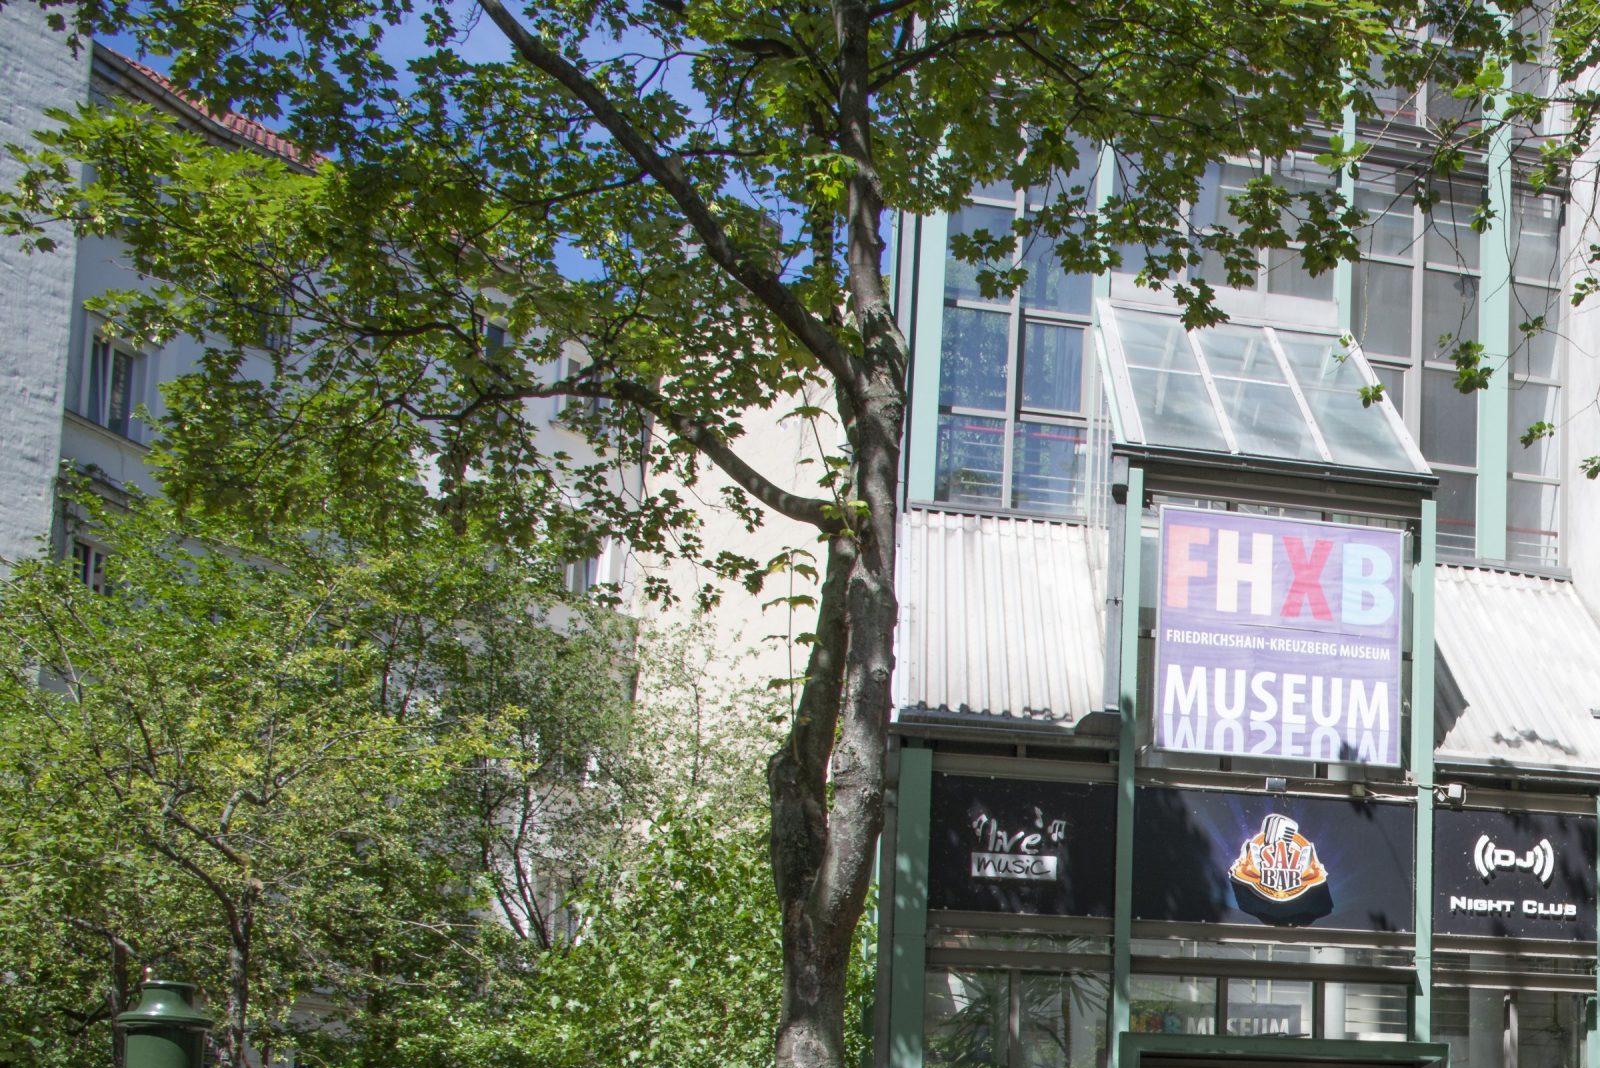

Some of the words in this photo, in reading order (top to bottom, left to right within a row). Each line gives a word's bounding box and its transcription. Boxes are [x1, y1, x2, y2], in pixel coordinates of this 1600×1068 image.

[1166, 524, 1395, 626] FHXB
[1166, 629, 1337, 657] FRIEDRICHSHAIN-KREUZBERG
[1340, 646, 1391, 661] MUSEUM
[1163, 663, 1390, 731] MUSEUM
[987, 818, 1041, 854] live
[977, 857, 1051, 875] music
[1261, 840, 1302, 870] SAZ
[1494, 849, 1534, 868] DJ
[1262, 869, 1302, 890] BAR
